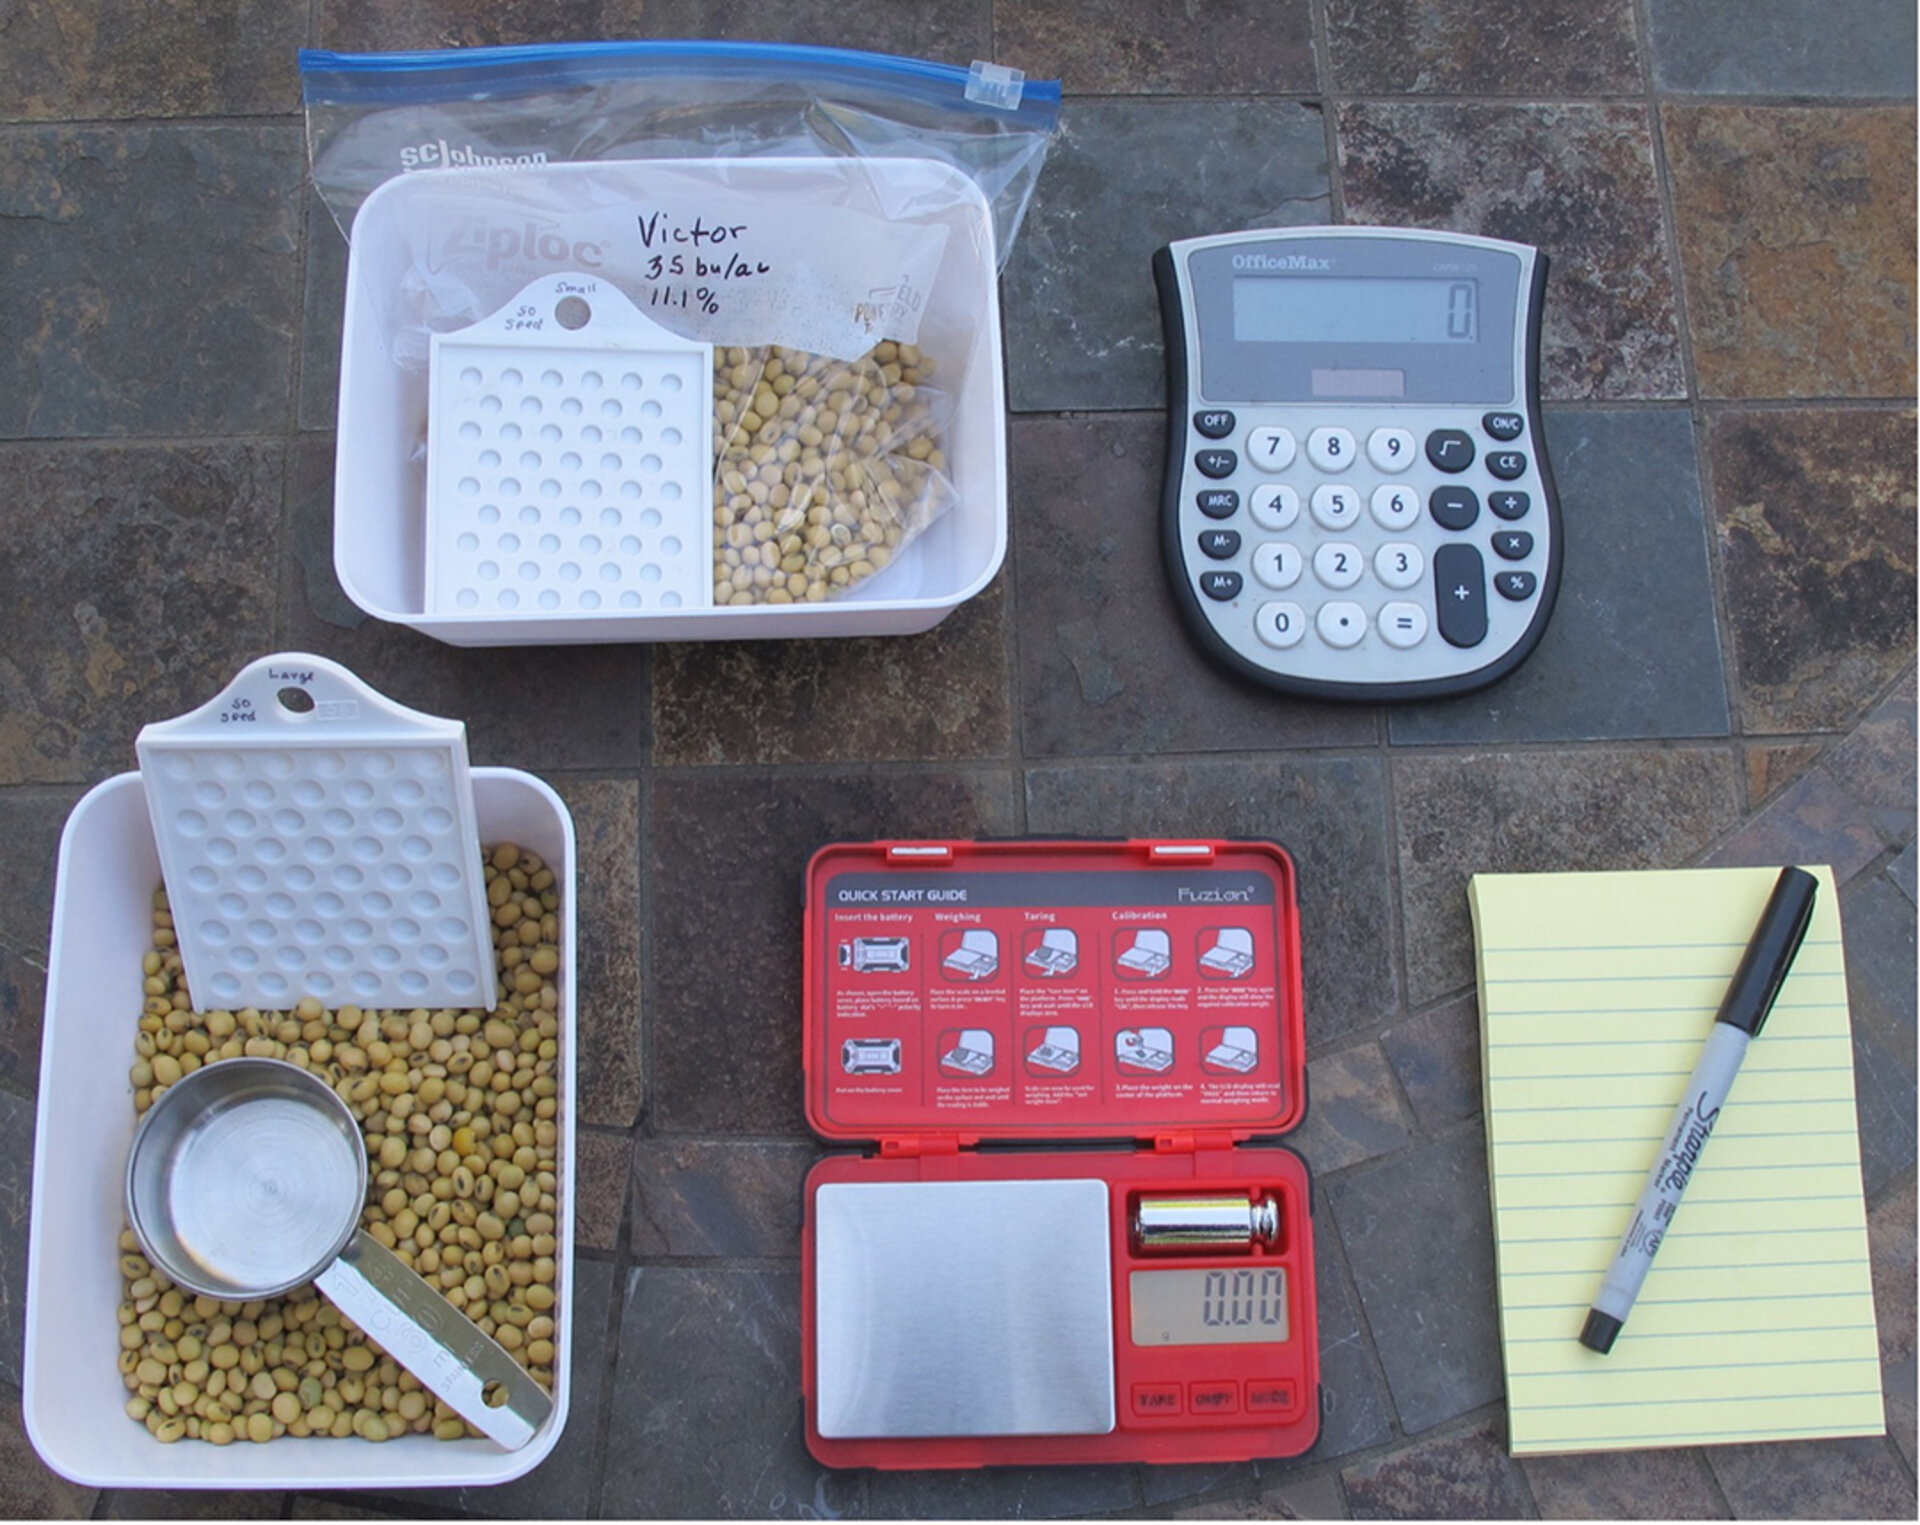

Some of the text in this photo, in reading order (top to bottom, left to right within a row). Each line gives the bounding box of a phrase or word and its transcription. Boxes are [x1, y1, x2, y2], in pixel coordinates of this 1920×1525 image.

[637, 211, 747, 248] Victor
[441, 213, 603, 272] Ziploc
[1232, 254, 1331, 270] OfficeMax
[555, 281, 597, 294] Small
[651, 286, 719, 315] 11.1%
[1204, 414, 1229, 427] OFF
[1492, 416, 1519, 431] ON/C
[1267, 436, 1281, 456] 7
[1327, 437, 1341, 457] 8
[1388, 437, 1401, 457] 9
[1499, 455, 1518, 469] CE
[1208, 494, 1233, 507] MRC
[1268, 494, 1283, 514] 4
[1331, 495, 1345, 514] 5
[1390, 495, 1404, 514] 6
[1273, 553, 1283, 573] 1
[1334, 554, 1348, 573] 2
[1395, 553, 1409, 573] 3
[1213, 575, 1233, 588] M+
[1275, 613, 1290, 633] 0
[268, 667, 315, 684] Large
[838, 889, 968, 902] QUICK START GUIDE
[1178, 886, 1250, 902] Fuzion
[834, 912, 914, 924] Insert the battery
[934, 912, 982, 924] Weighing
[1023, 911, 1056, 923] Taring
[1111, 910, 1168, 921] Calibration
[1665, 1090, 1720, 1191] Sharpie
[1203, 1271, 1283, 1327] 0.00
